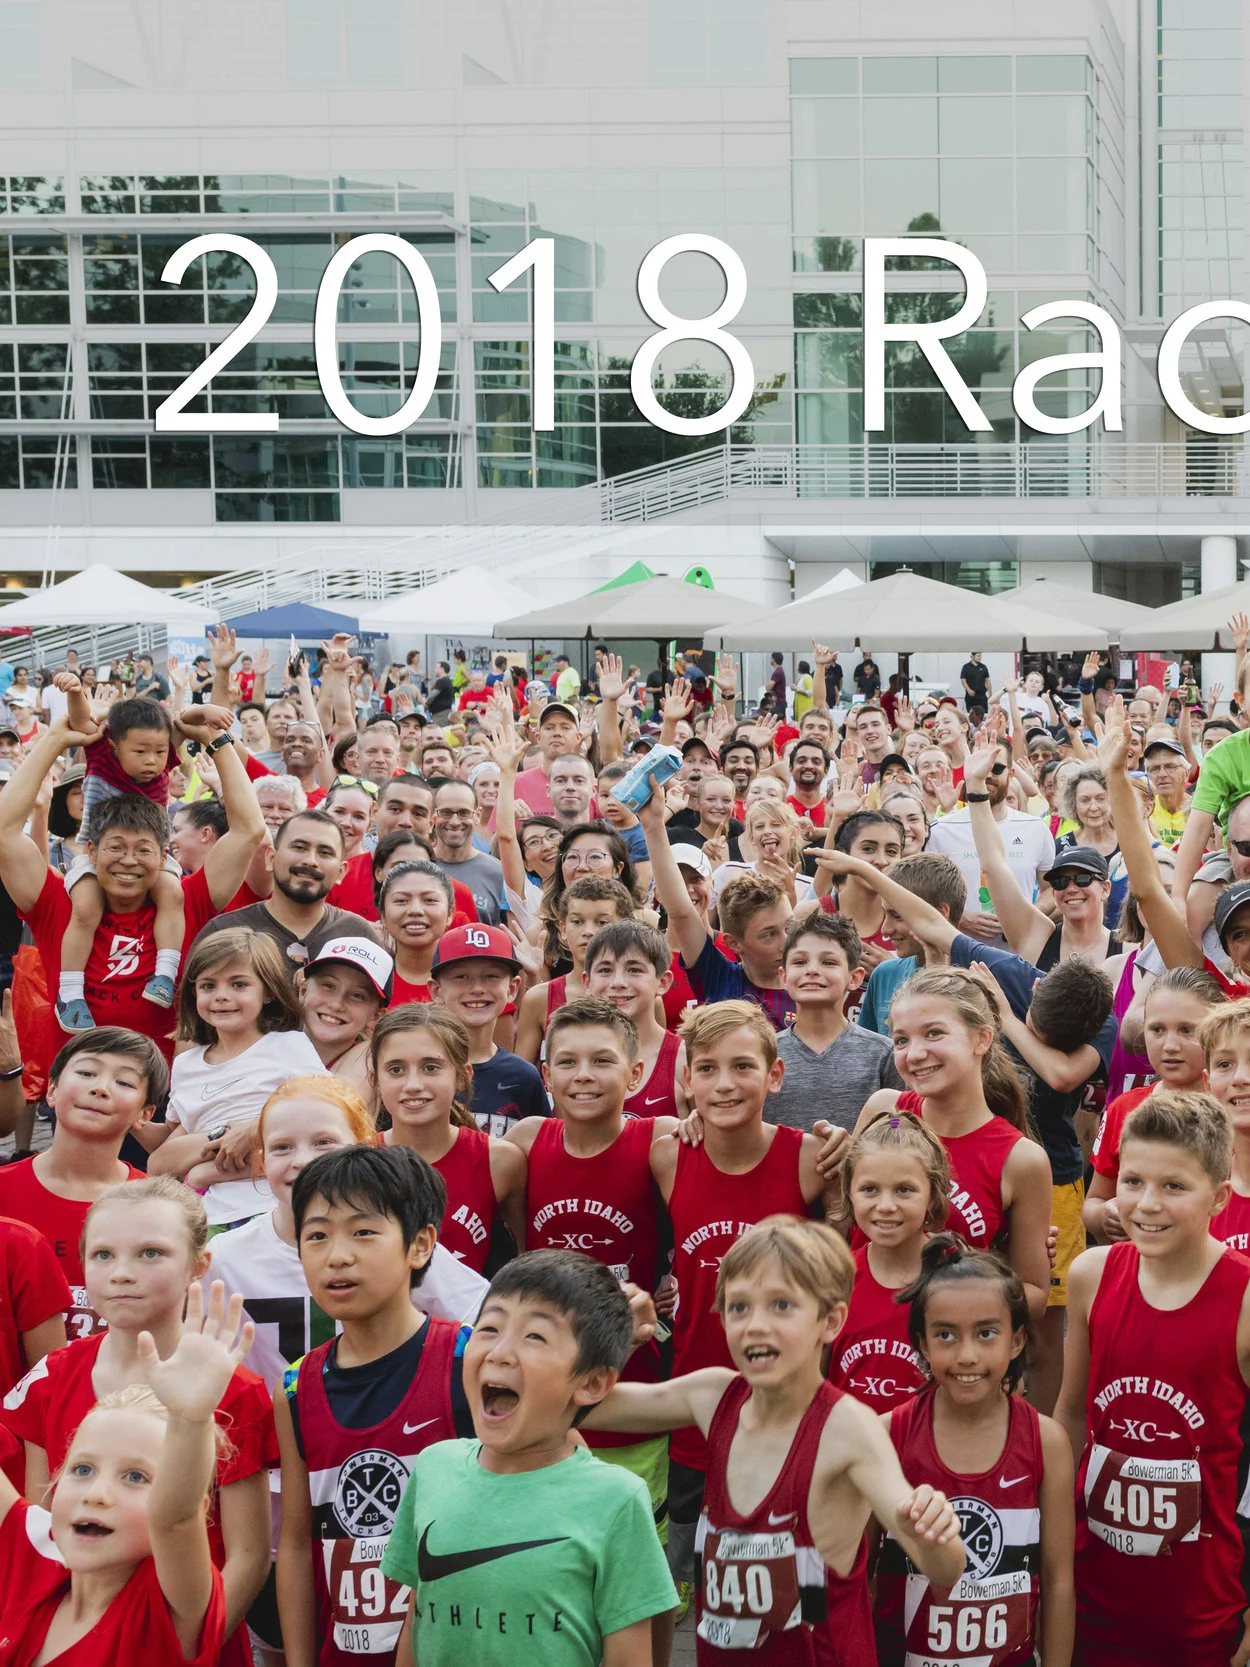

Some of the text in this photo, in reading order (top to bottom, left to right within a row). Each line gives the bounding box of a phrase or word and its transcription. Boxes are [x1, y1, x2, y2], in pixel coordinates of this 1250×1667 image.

[347, 945, 378, 966] ROLL
[451, 1204, 488, 1245] AHO
[532, 1198, 635, 1235] NORTH IDAHO
[562, 1233, 594, 1250] XC
[681, 1220, 734, 1256] NORTH
[839, 1338, 922, 1374] NORTH IDA
[863, 1376, 896, 1397] XC
[1093, 1376, 1205, 1430] NORTH IDAHO
[1122, 1418, 1157, 1443] XC
[1127, 1460, 1179, 1481] Bowerman
[1103, 1479, 1178, 1530] 405
[721, 1535, 770, 1558] Bowerman
[1102, 1528, 1135, 1554] 2018
[706, 1559, 774, 1615] 840
[960, 1579, 1010, 1600] Bowerman
[341, 1629, 370, 1651] 2018
[927, 1603, 1008, 1653] 566
